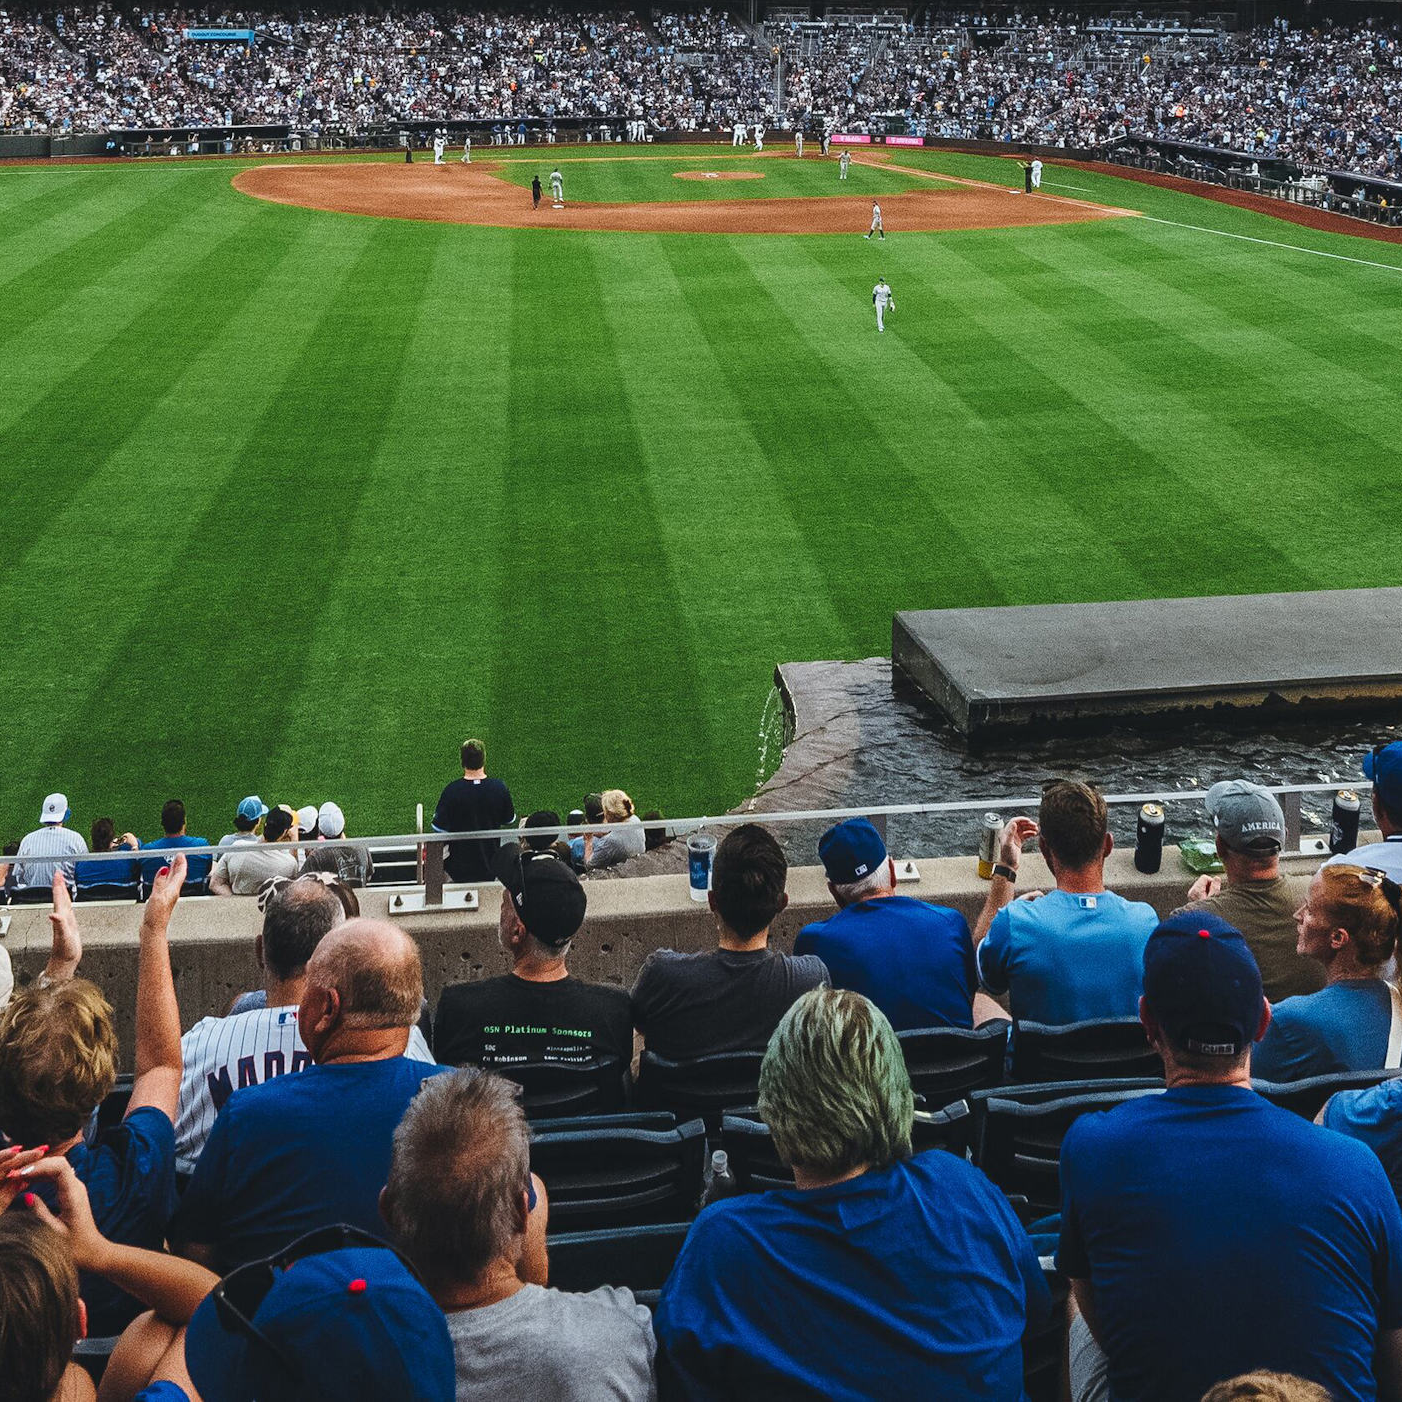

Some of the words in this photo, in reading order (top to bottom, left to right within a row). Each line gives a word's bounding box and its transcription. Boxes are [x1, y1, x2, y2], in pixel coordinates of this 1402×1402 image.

[1241, 821, 1282, 833] AMERICA
[484, 1026, 500, 1034] OSN
[504, 1025, 548, 1034] Platinum
[552, 1026, 592, 1038] Sponsors
[494, 1055, 528, 1063] Robinson
